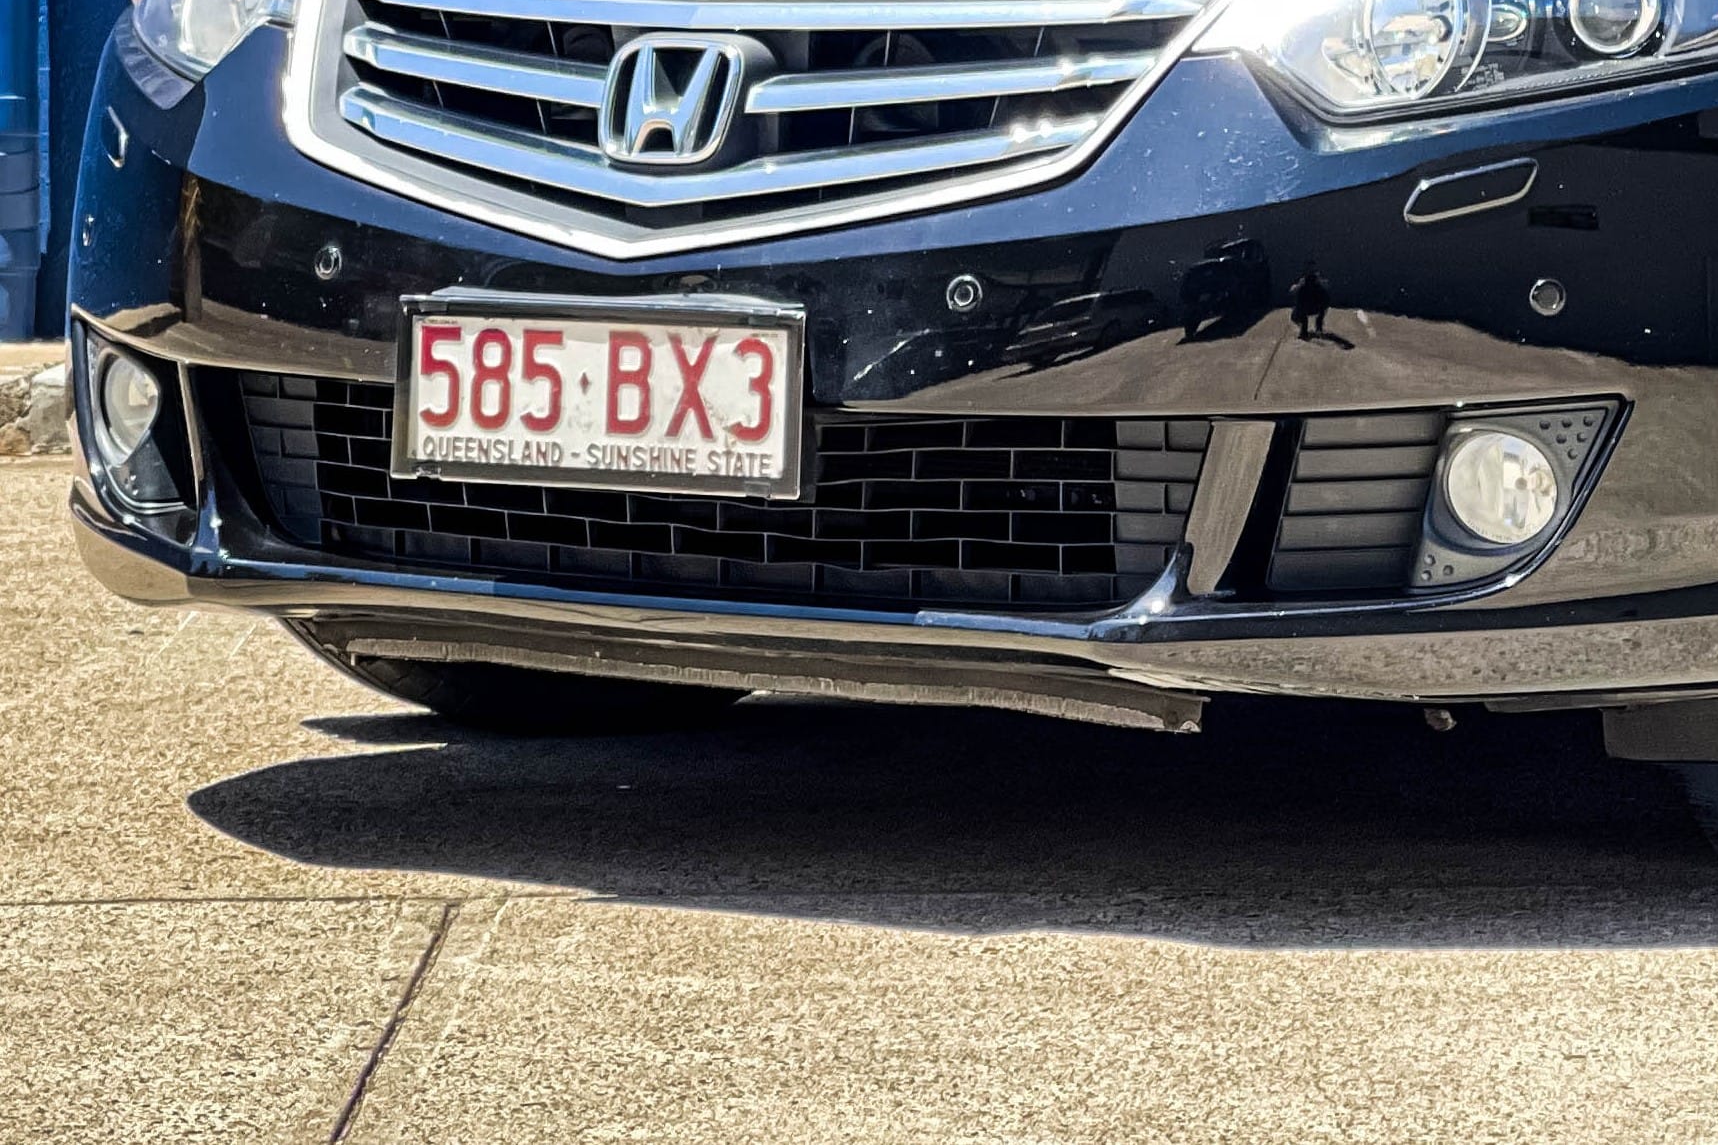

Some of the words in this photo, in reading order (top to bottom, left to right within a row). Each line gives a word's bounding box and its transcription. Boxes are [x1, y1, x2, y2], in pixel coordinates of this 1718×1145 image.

[422, 435, 564, 466] QUEENSLAND
[586, 443, 697, 471] SUNSHINE
[707, 450, 772, 476] STATE
